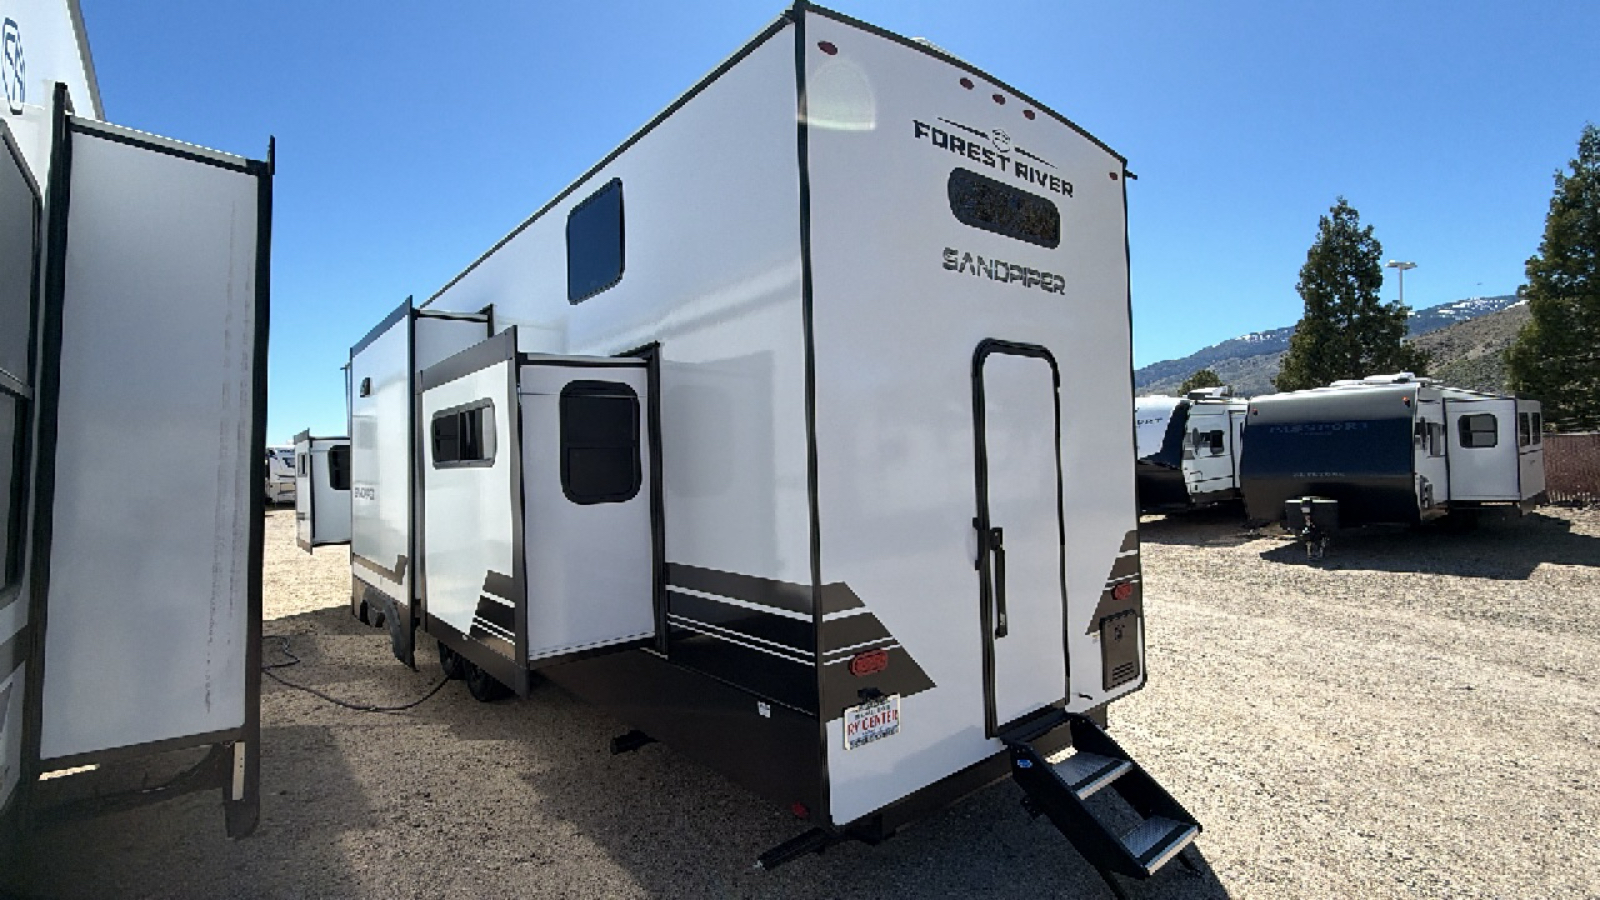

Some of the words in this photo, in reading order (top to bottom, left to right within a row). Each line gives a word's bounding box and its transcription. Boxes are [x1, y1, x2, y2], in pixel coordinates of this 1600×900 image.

[913, 119, 1011, 172] FOREST
[1014, 160, 1074, 198] RIVER
[942, 247, 1066, 296] SANDPIPER
[862, 709, 899, 731] CENTER
